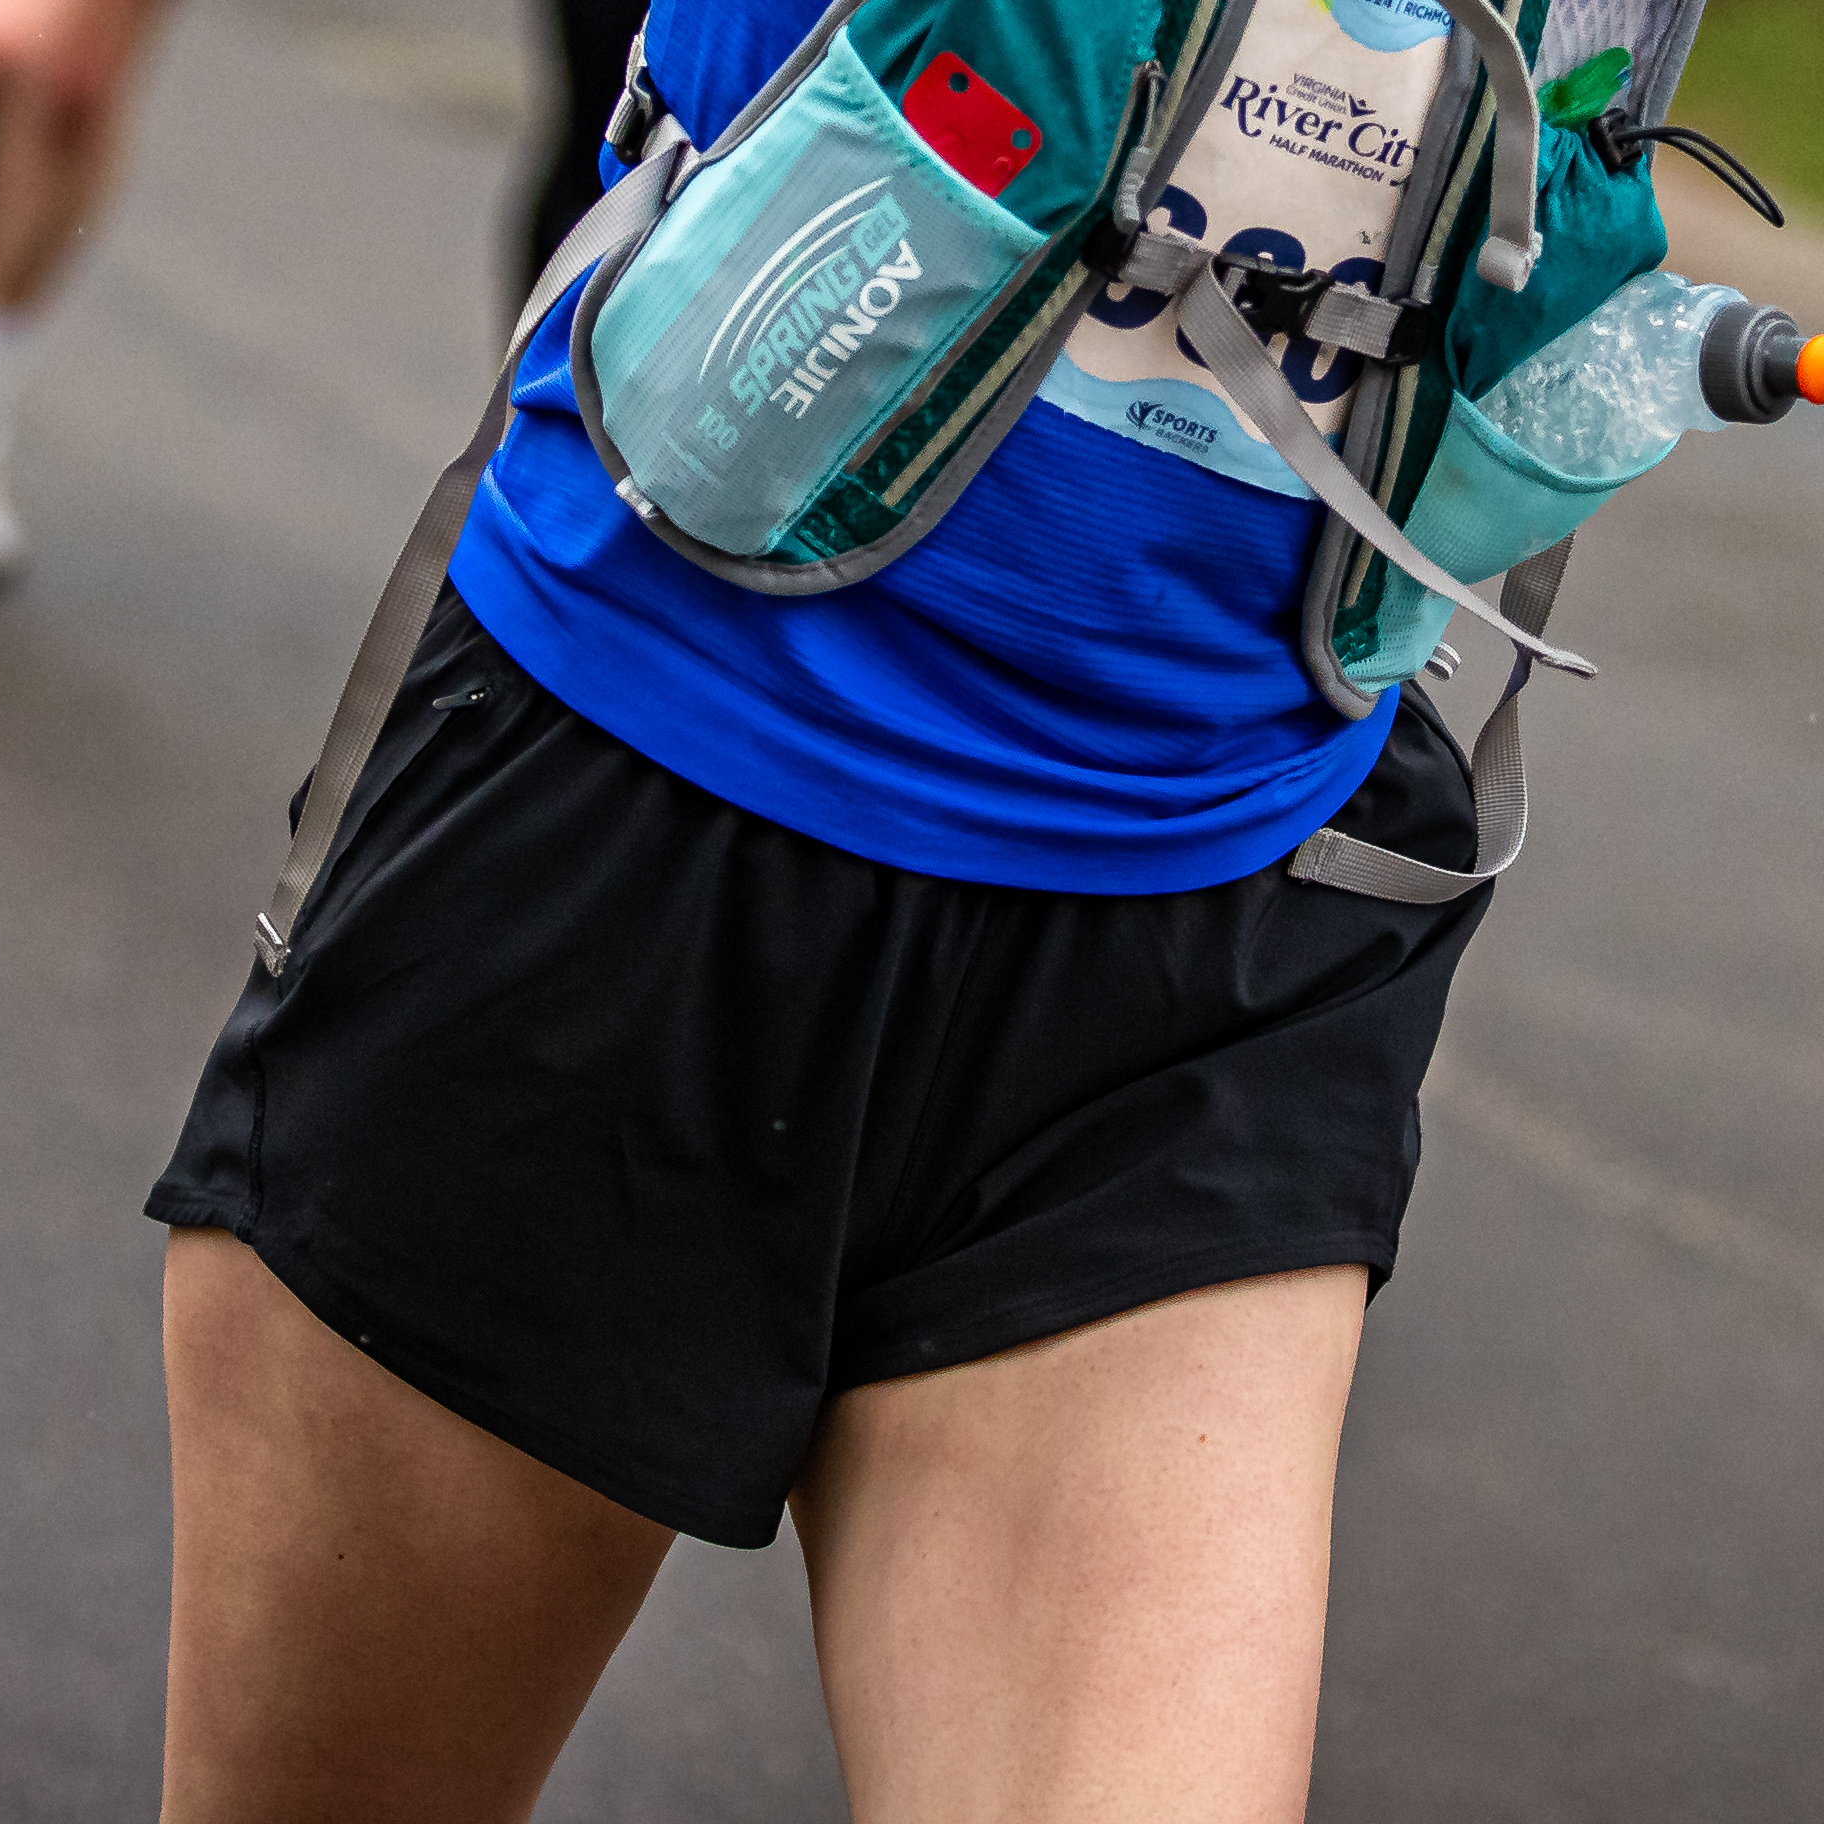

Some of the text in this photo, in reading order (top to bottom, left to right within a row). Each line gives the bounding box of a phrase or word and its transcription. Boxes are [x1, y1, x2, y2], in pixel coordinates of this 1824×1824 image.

[1403, 1, 1454, 27] RICHMO
[1220, 75, 1343, 138] River
[1293, 73, 1346, 102] VIRGINIA
[1268, 133, 1385, 182] HALF MARATHON
[728, 249, 864, 417] SPRING
[770, 239, 923, 420] AONIJIE
[1152, 408, 1218, 444] SPORTS
